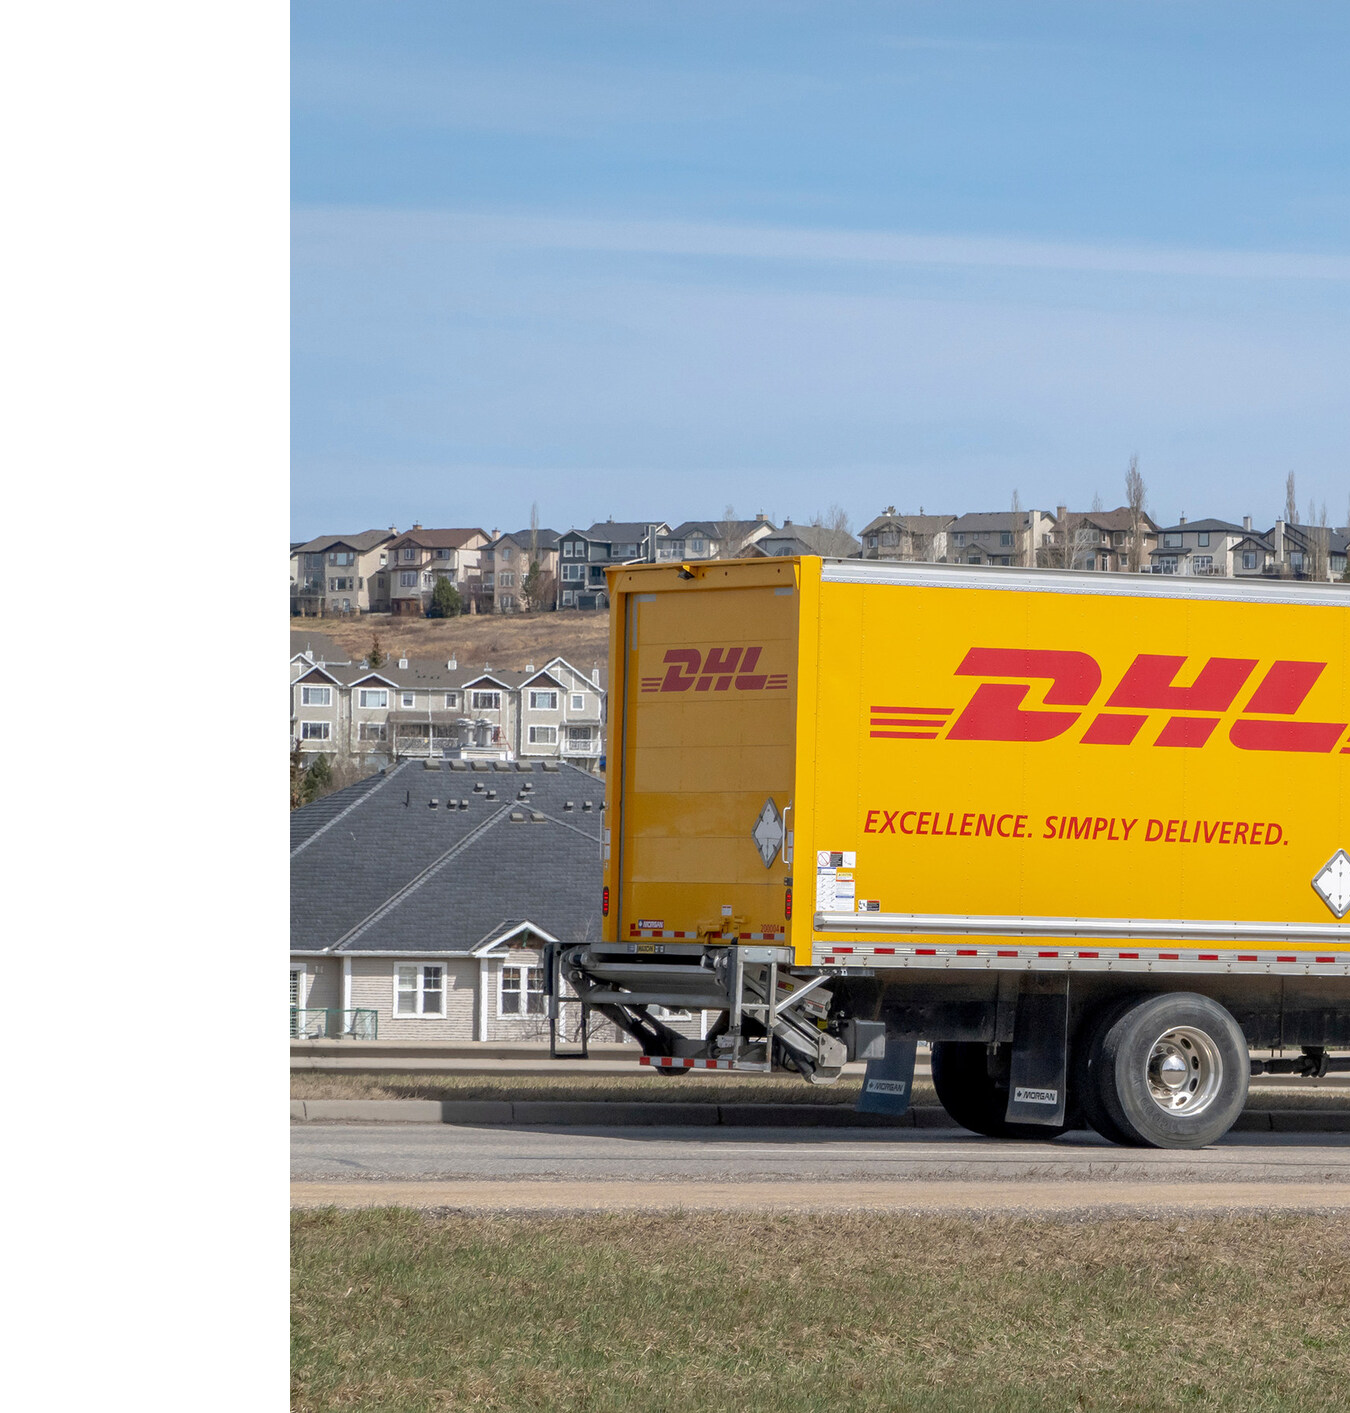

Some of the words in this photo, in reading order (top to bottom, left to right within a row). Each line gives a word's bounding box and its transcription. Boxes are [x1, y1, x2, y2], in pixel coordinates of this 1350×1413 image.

[661, 647, 768, 692] DHL
[945, 647, 1348, 755] DHL
[864, 810, 1033, 839] EXCELLENCE.
[1042, 816, 1139, 841] SIMPLY
[1144, 819, 1289, 846] DELIVERED.
[642, 921, 664, 929] MORGAN
[874, 1082, 904, 1092] MORGAN
[1023, 1090, 1056, 1101] MORGAN
